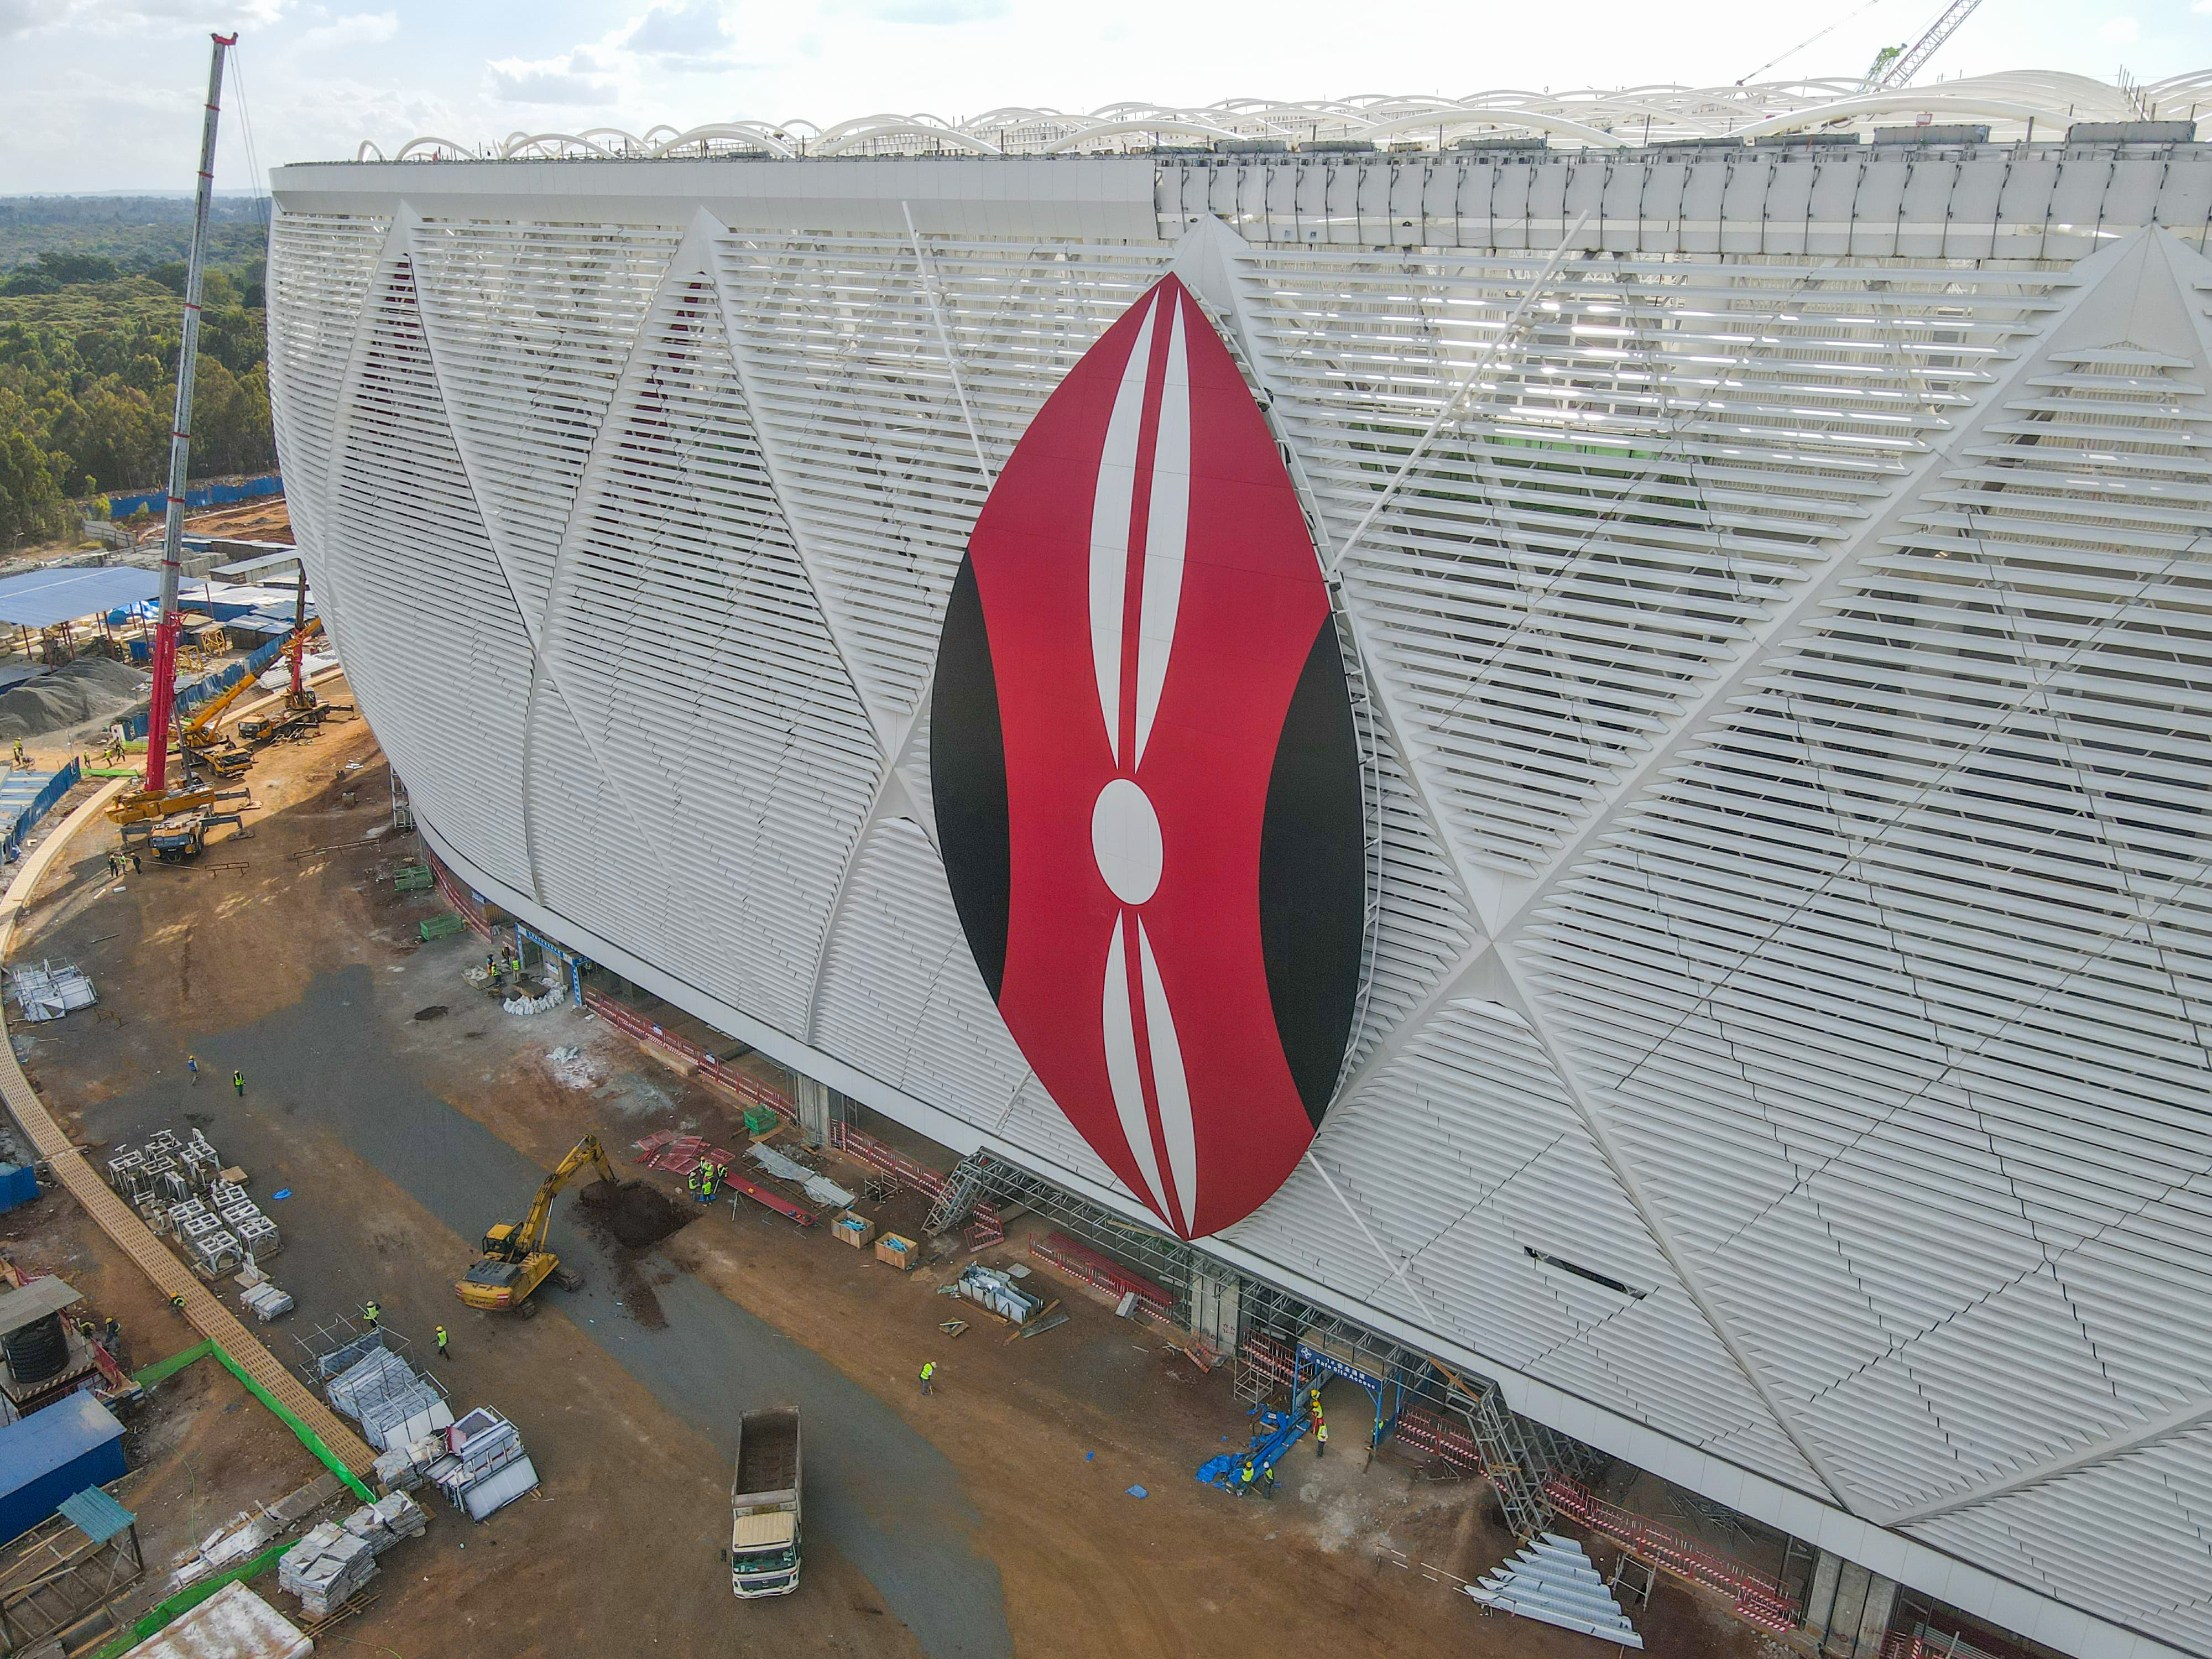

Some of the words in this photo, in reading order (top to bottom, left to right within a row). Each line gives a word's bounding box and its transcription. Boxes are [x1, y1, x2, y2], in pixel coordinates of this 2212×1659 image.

[1316, 1359, 1332, 1370] Safe
[1333, 1366, 1348, 1377] Site
[1349, 1374, 1376, 1390] Access
